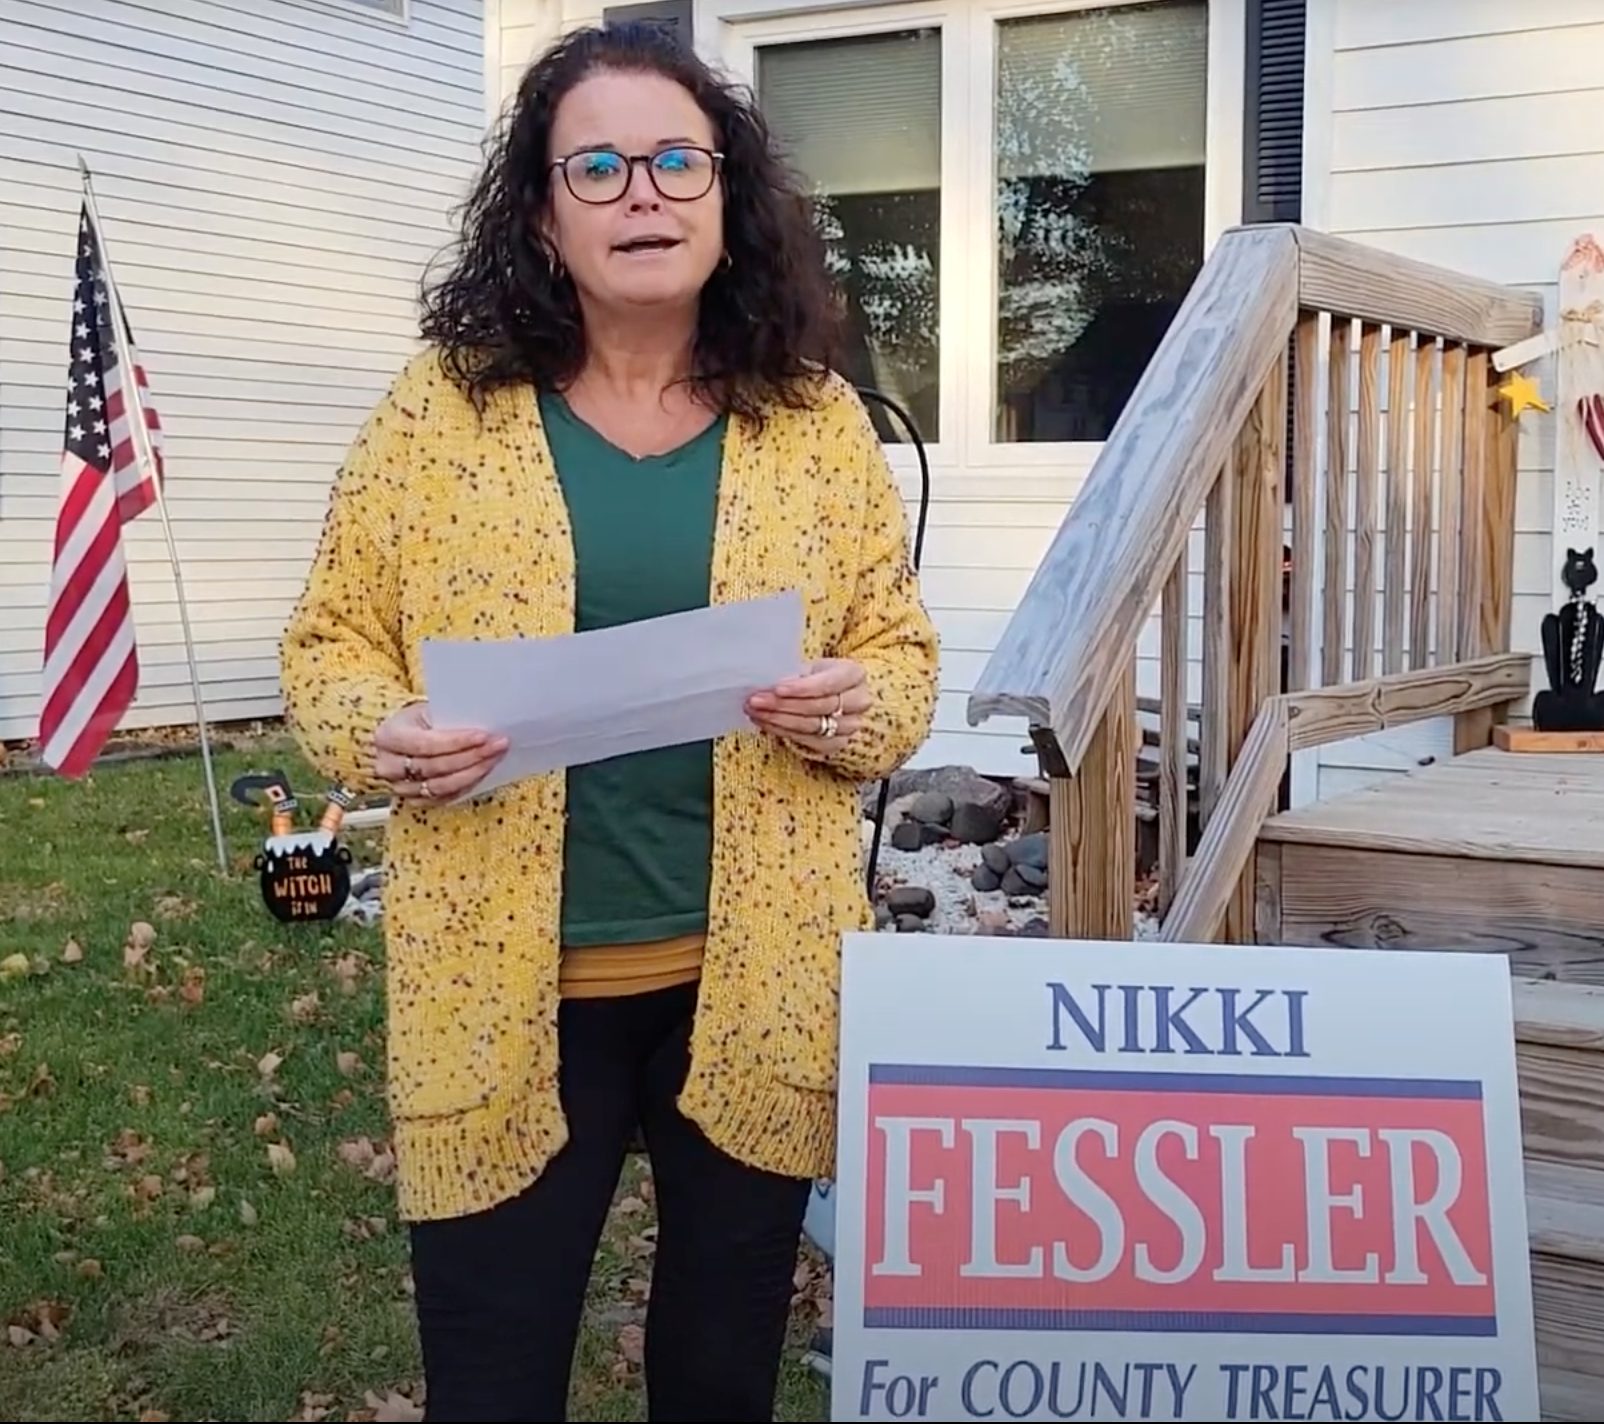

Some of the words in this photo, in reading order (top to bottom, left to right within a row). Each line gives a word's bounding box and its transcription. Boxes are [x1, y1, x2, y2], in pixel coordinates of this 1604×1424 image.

[1045, 982, 1311, 1058] NIKKI
[871, 1116, 1488, 1288] FESSLER
[859, 1359, 939, 1418] For
[961, 1359, 1198, 1418] COUNTY
[1219, 1364, 1504, 1422] TREASURER
